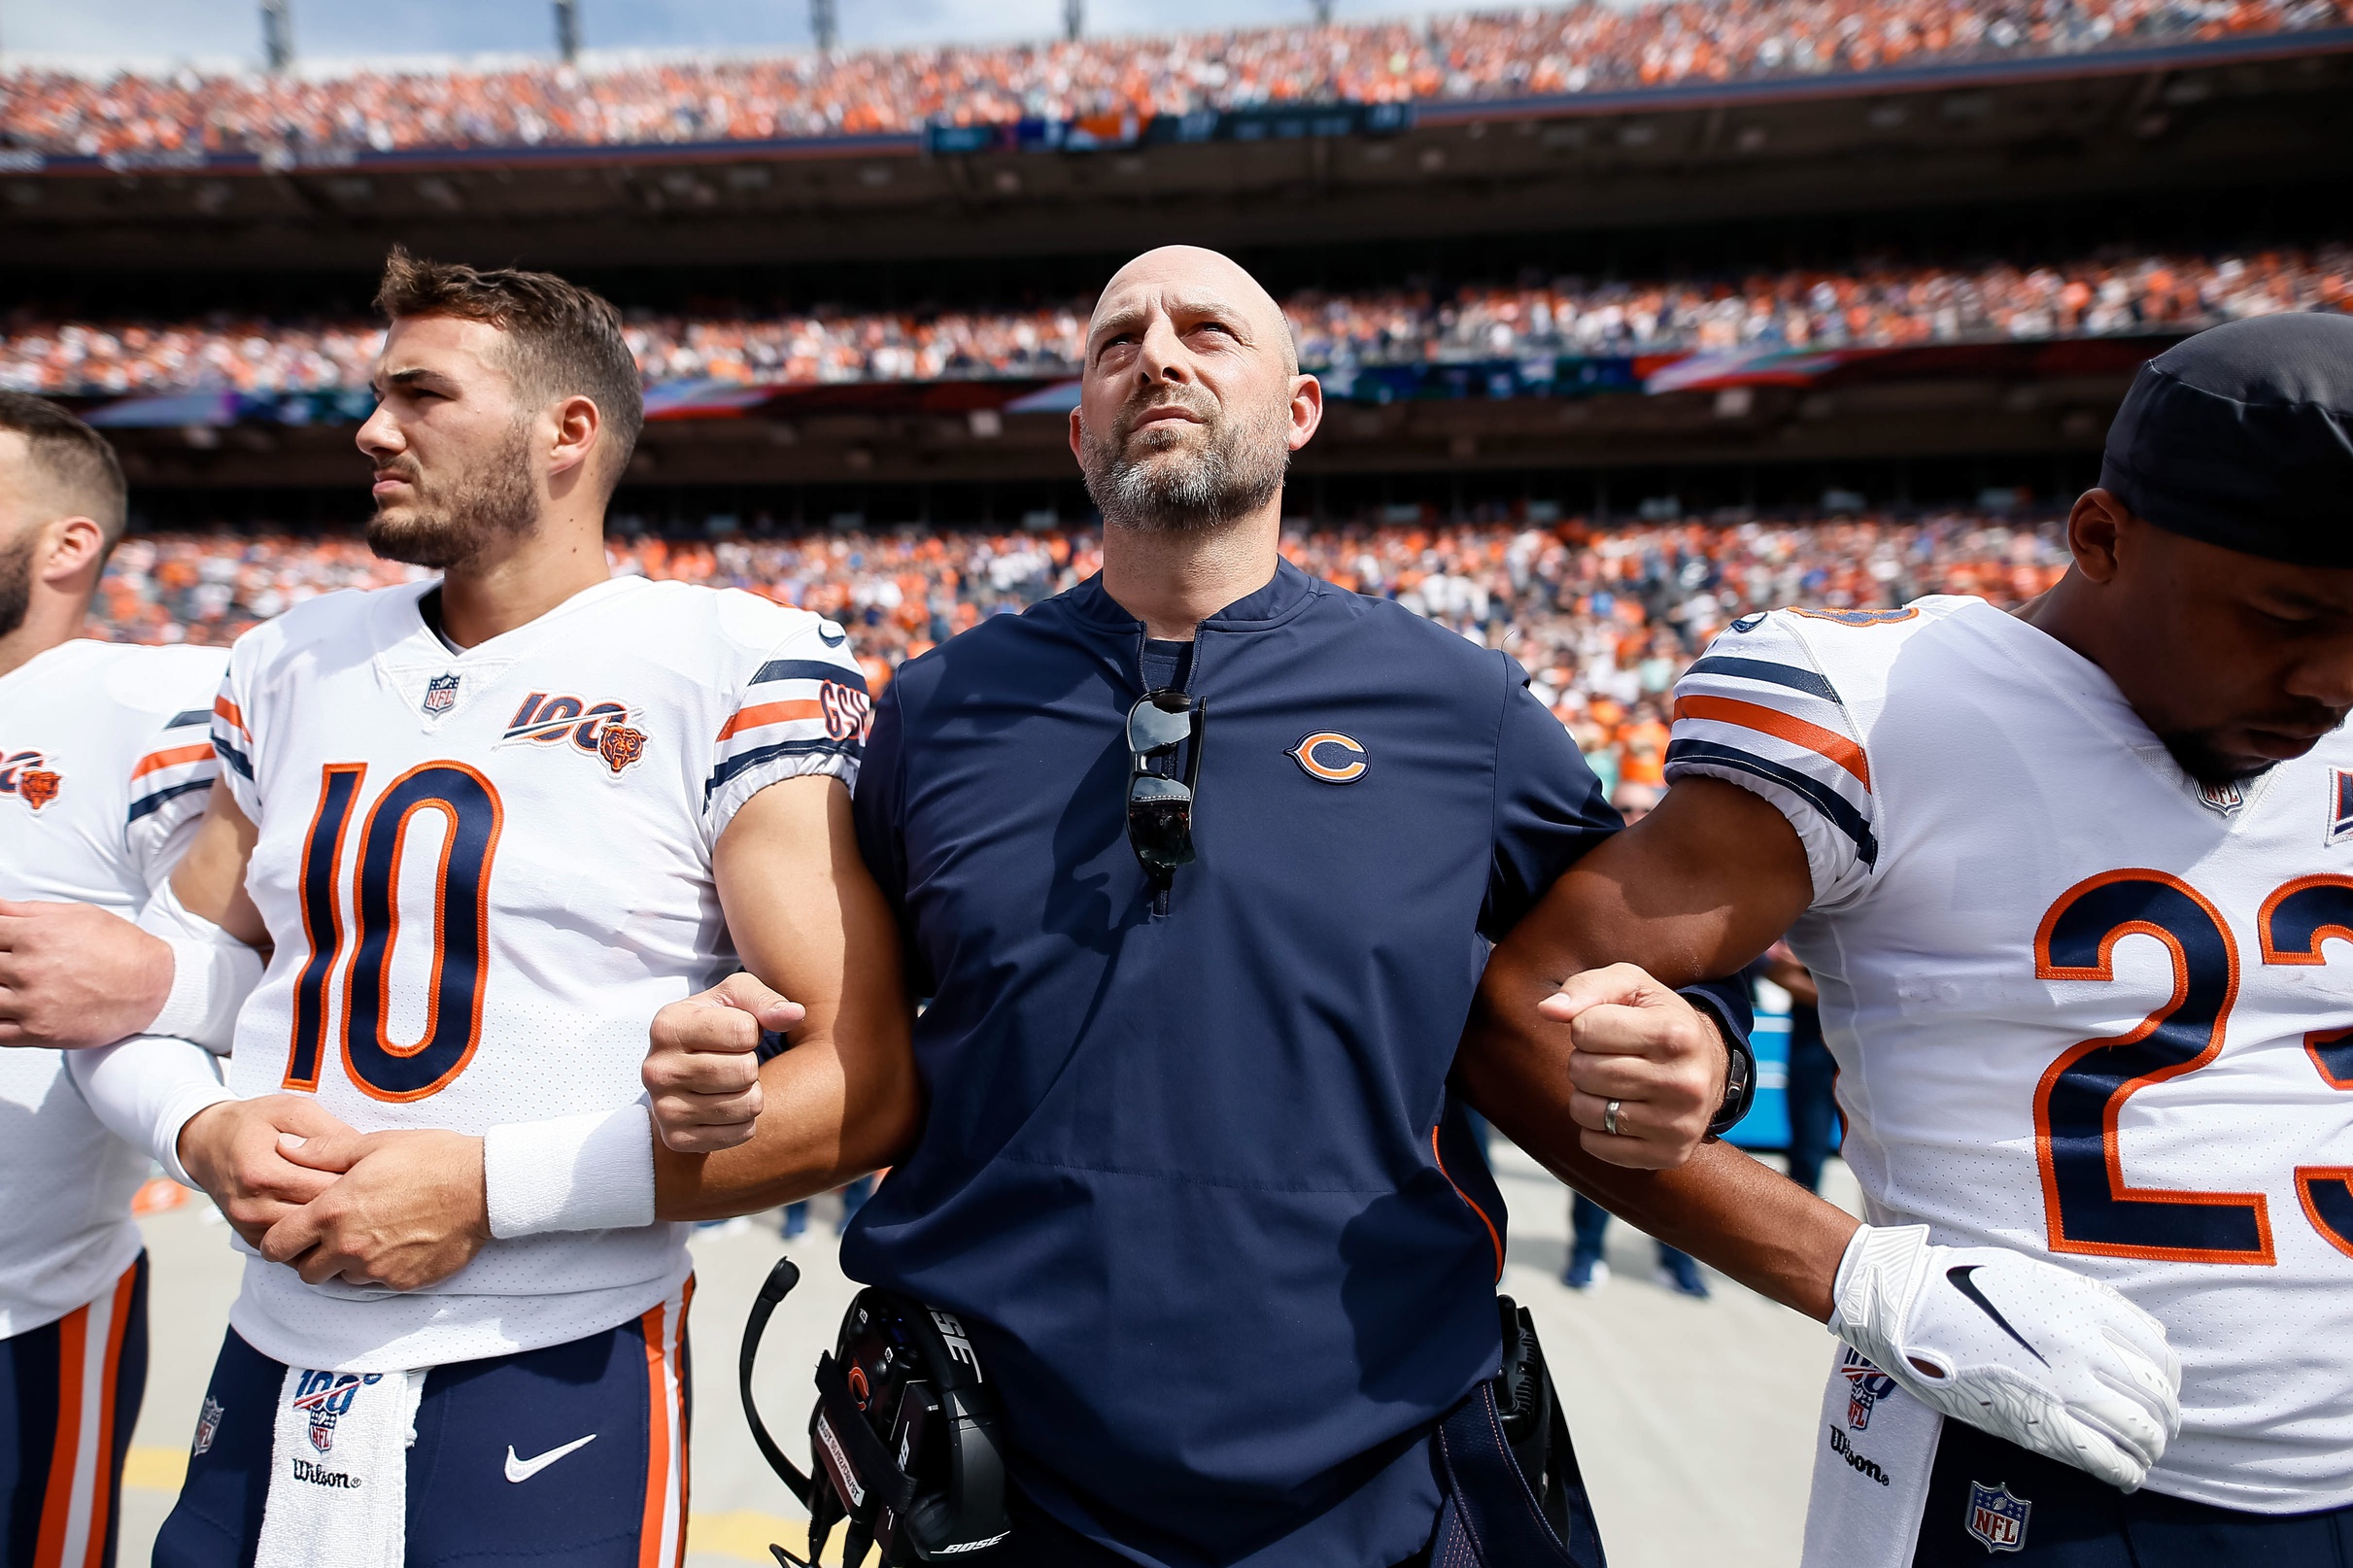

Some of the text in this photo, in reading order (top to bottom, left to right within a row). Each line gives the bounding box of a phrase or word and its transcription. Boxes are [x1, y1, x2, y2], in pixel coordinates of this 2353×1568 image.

[427, 690, 453, 707] NFL
[503, 692, 628, 751] 100
[2205, 782, 2239, 804] NFL
[282, 759, 504, 1104] 10
[930, 1312, 982, 1383] SE
[312, 1426, 330, 1449] NFL
[1973, 1507, 2017, 1543] NFL
[930, 1530, 1011, 1554] BOSE
